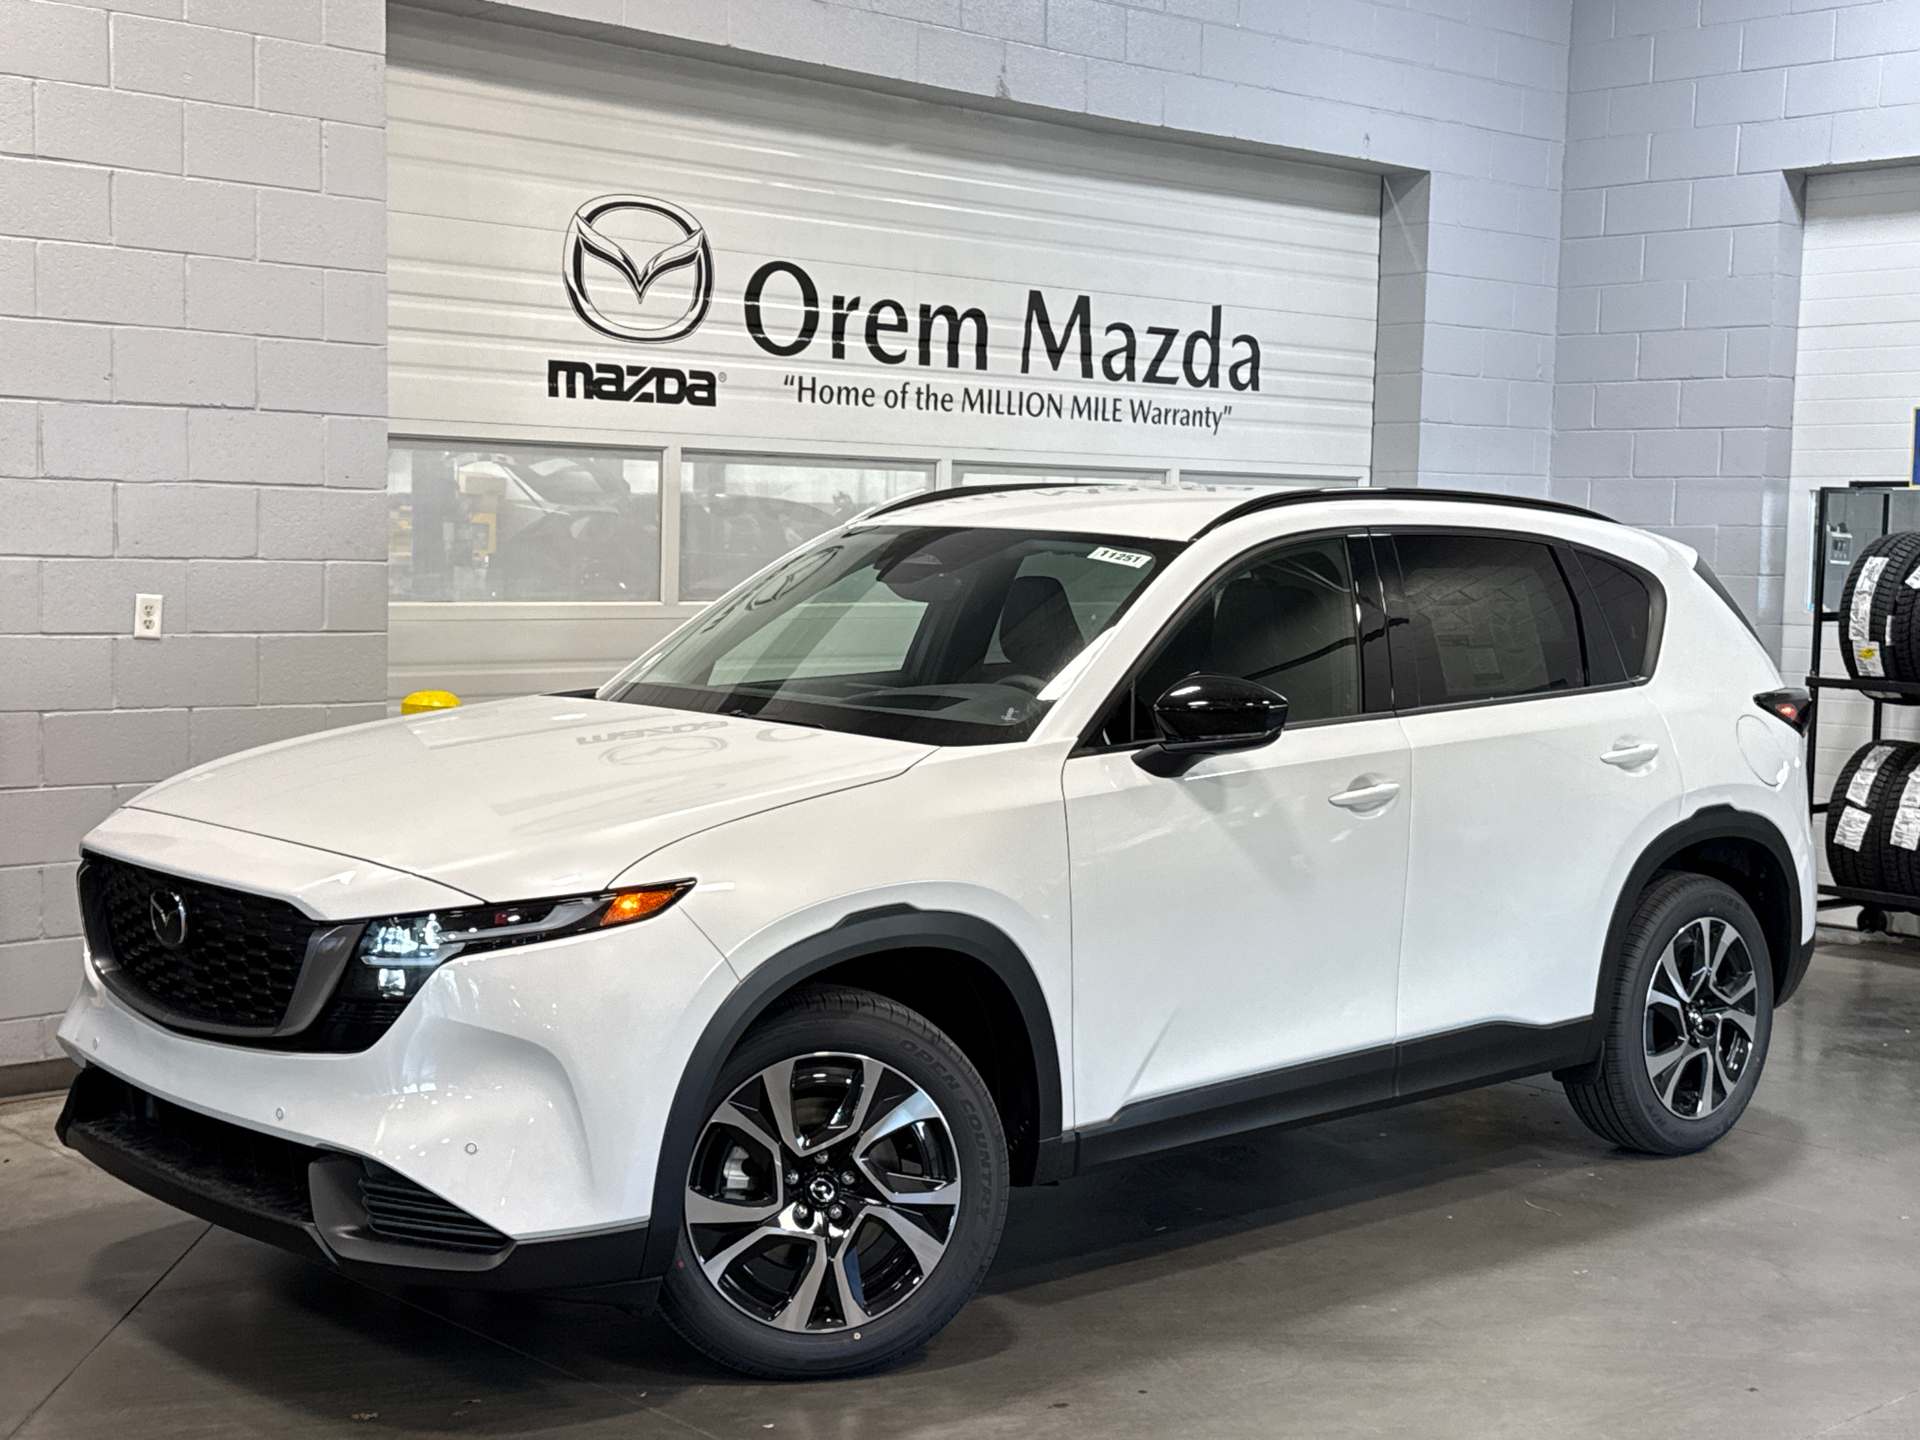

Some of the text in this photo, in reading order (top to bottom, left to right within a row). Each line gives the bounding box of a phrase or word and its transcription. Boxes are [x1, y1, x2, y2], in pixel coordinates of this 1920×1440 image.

[744, 261, 1261, 392] Orem Mazda
[783, 374, 1232, 436] “Home of the MILLION MILE Warranty”
[1099, 550, 1141, 563] 11251
[900, 1039, 961, 1091] OPEN
[962, 1098, 993, 1222] COUNTRY
